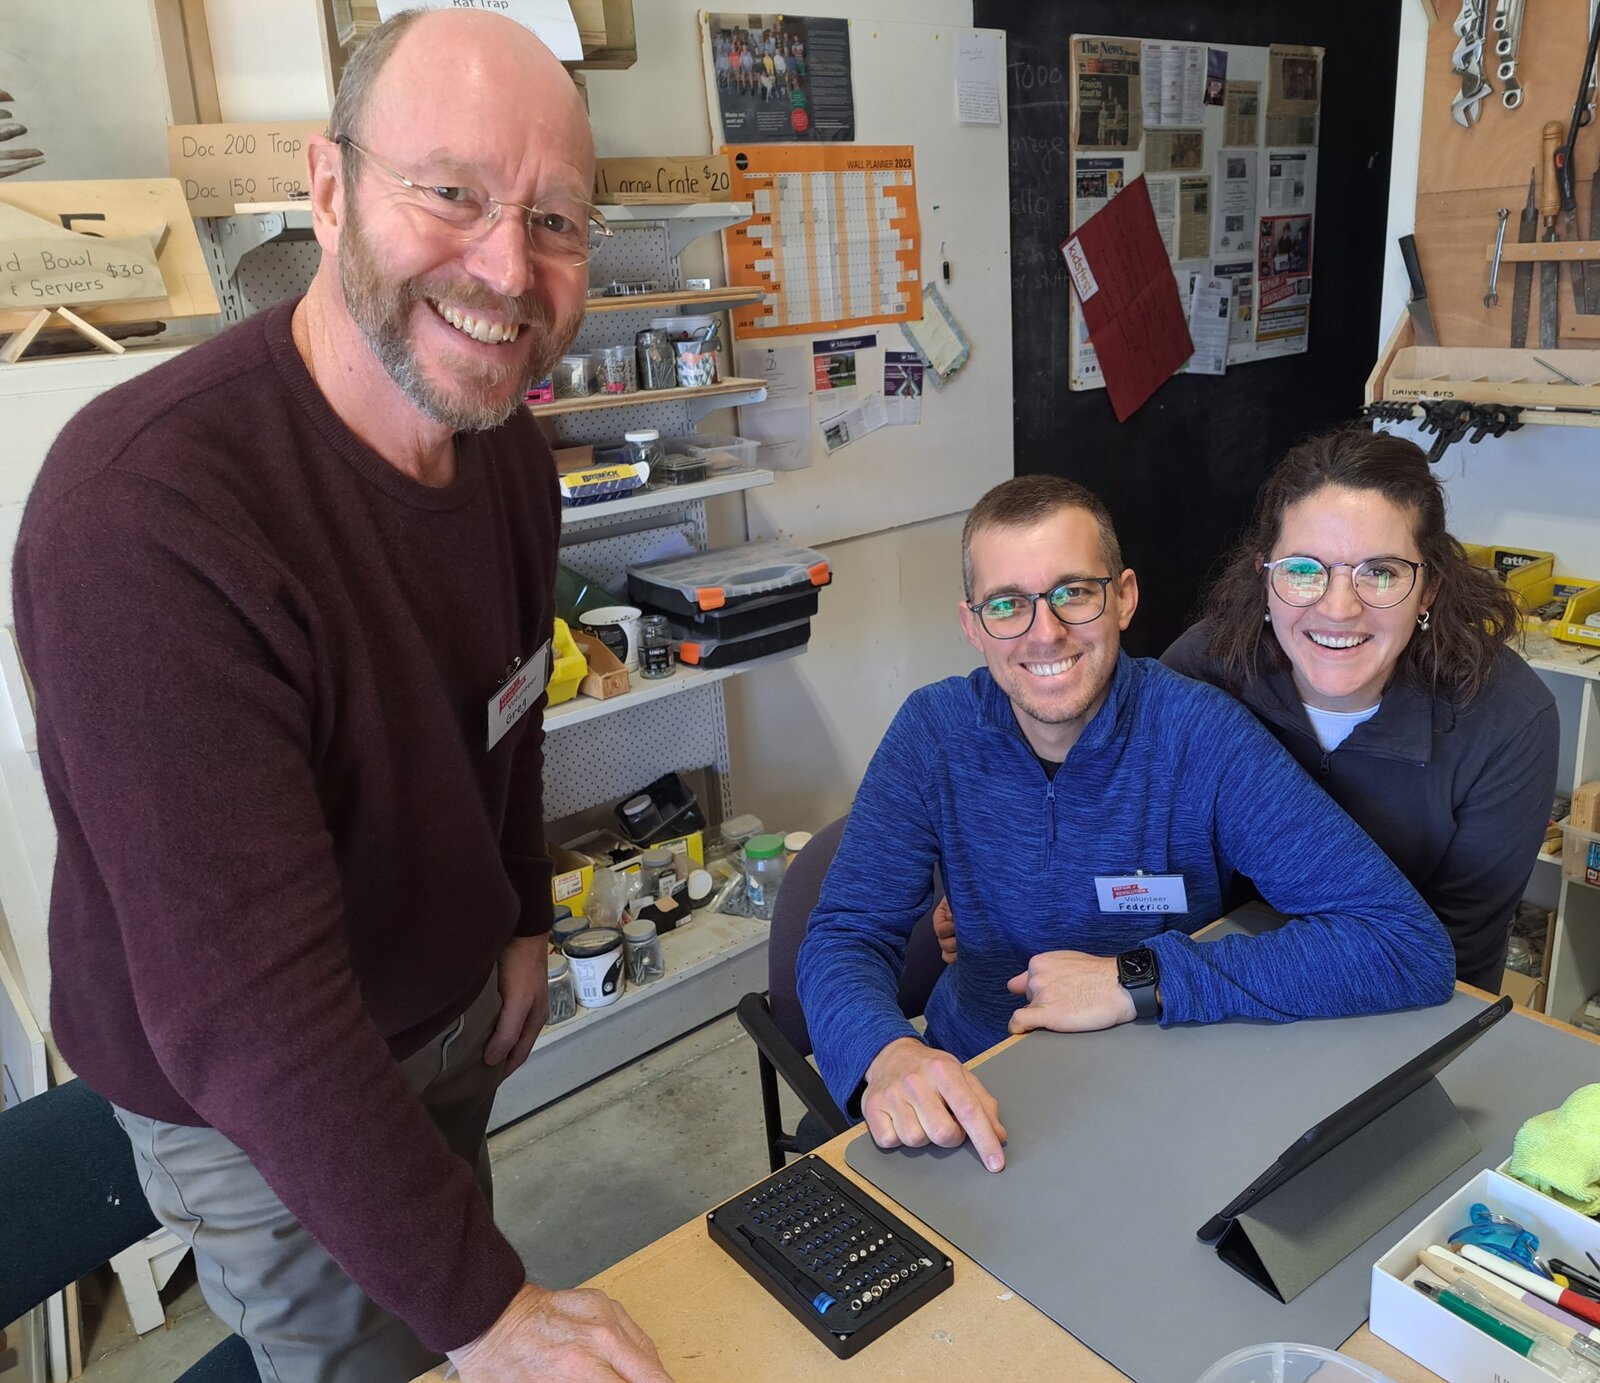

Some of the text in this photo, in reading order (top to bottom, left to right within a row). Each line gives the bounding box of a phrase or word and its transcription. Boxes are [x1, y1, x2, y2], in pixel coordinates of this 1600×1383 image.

[1079, 40, 1124, 57] The News
[182, 132, 301, 159] Doc 200 Trap
[847, 158, 912, 169] WALL PLANNER 2023
[702, 164, 730, 192] $20
[185, 176, 301, 201] Doc 150 Trap
[41, 250, 92, 271] Bowl
[106, 262, 144, 279] $30
[30, 278, 104, 297] Servers
[1433, 390, 1454, 398] BITS
[1502, 556, 1532, 566] atla
[505, 698, 527, 725] Greg
[1119, 903, 1169, 911] Federico
